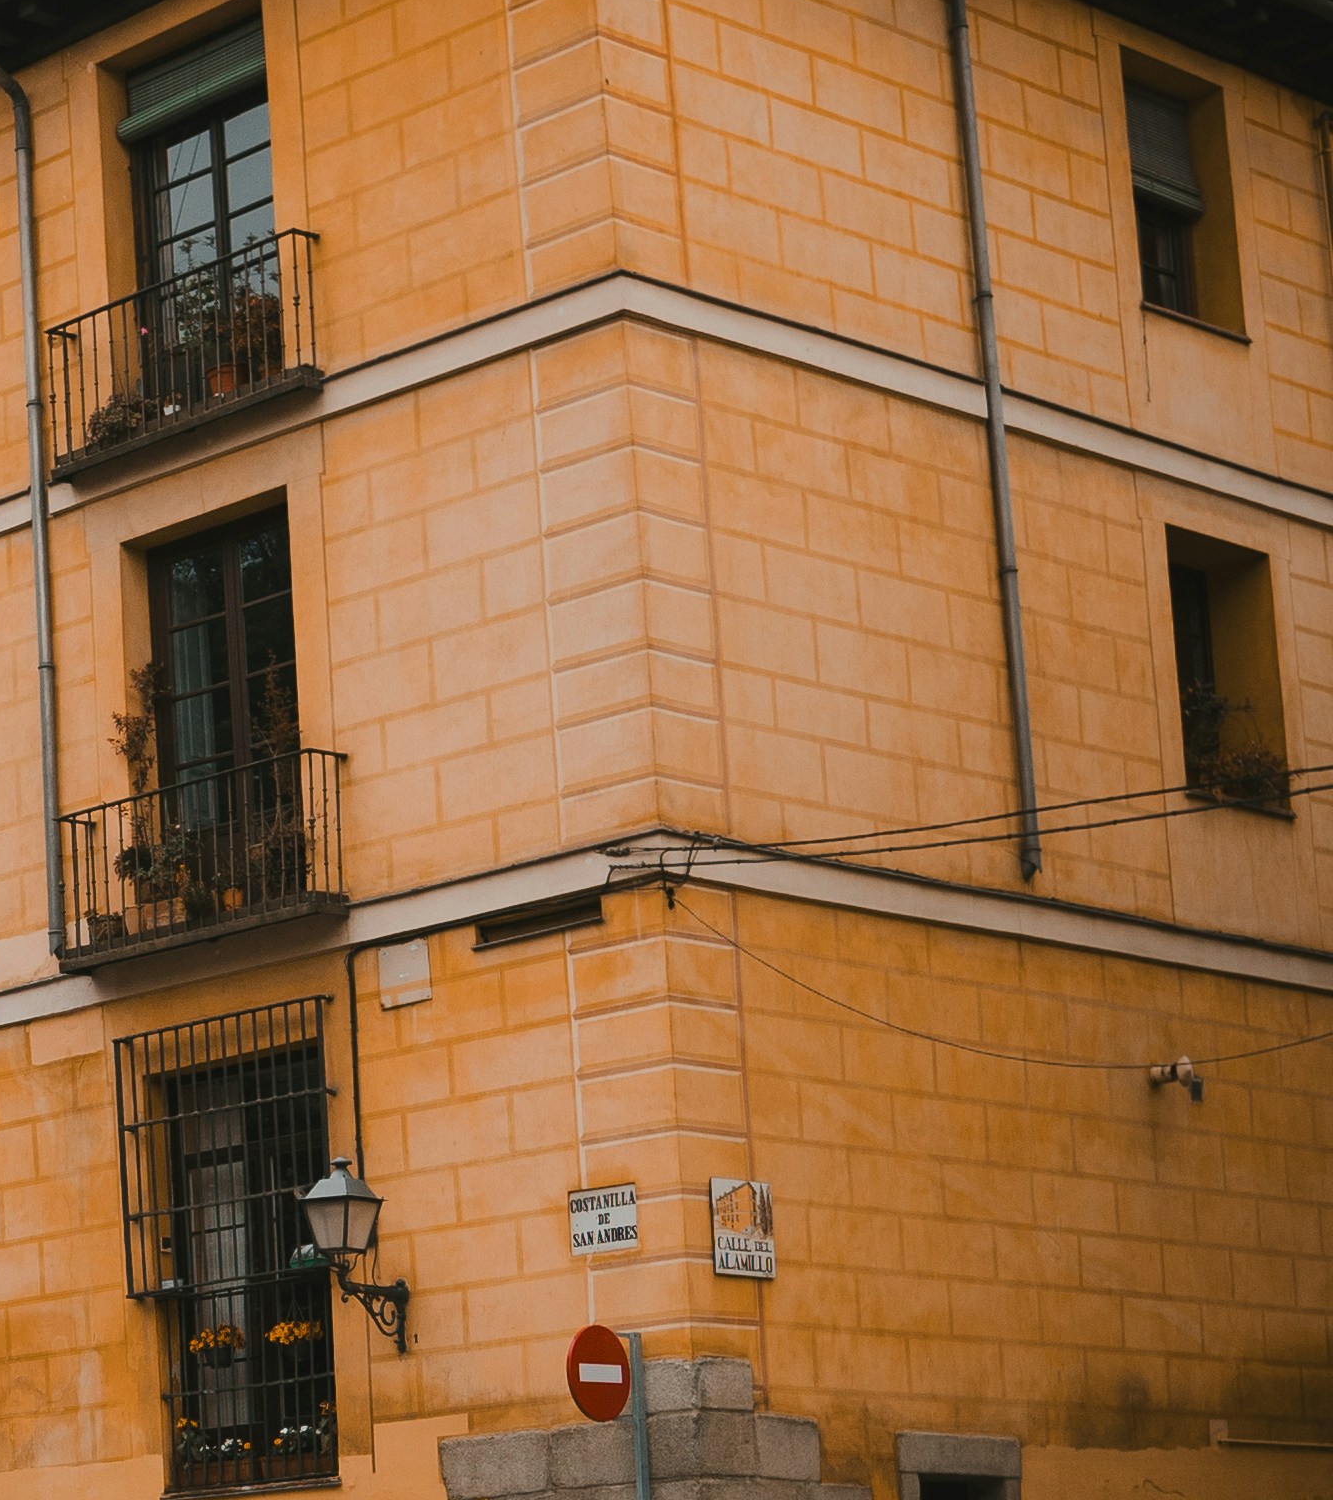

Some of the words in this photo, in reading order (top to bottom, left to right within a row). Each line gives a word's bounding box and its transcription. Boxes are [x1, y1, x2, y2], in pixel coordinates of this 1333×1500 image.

[570, 1190, 637, 1214] COSTANILLA
[597, 1212, 611, 1226] DE
[573, 1231, 595, 1248] SAN
[597, 1225, 638, 1244] ANDRES
[717, 1236, 752, 1252] CALLE
[754, 1241, 773, 1253] DEL
[718, 1252, 773, 1273] ALAMILLO
